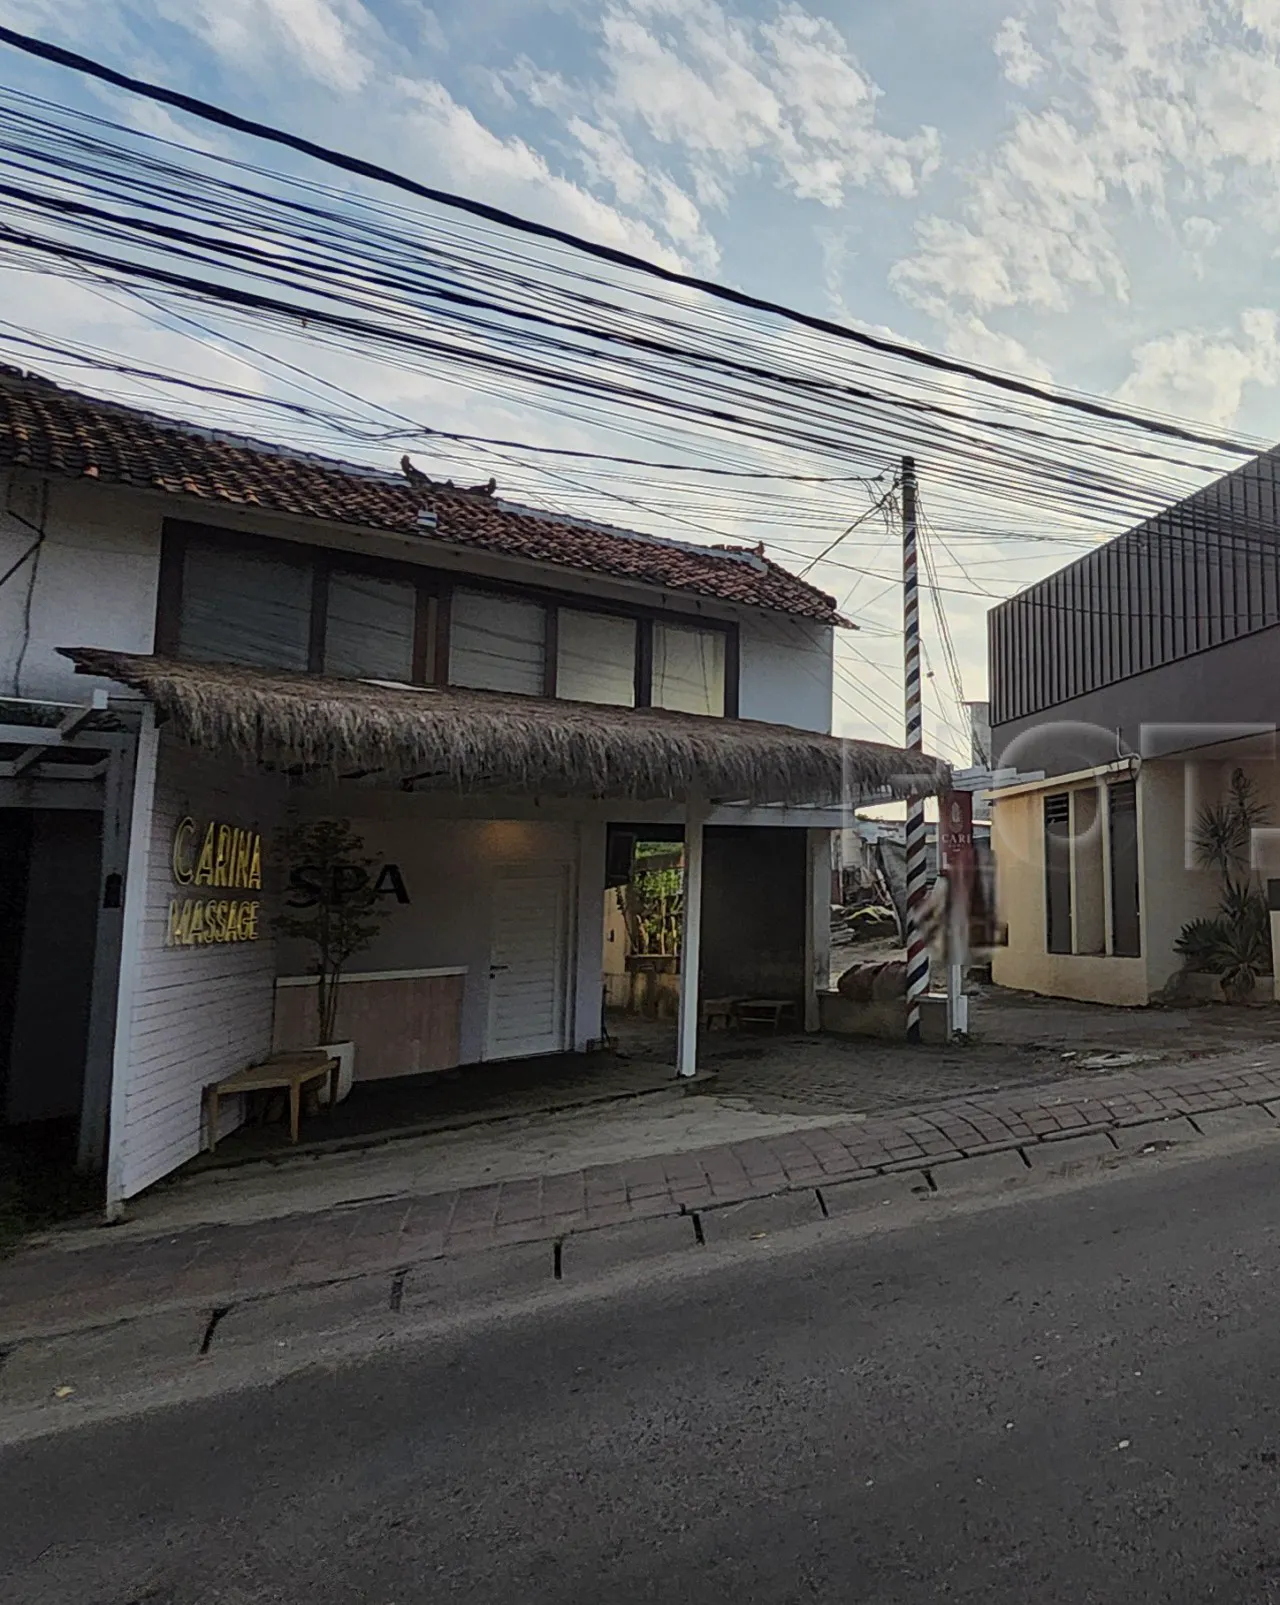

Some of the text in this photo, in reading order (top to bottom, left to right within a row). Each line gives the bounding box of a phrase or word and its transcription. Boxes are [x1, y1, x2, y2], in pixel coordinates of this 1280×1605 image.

[173, 816, 261, 889] CARINA
[287, 863, 411, 908] SPA
[167, 899, 259, 946] MASSAGE
